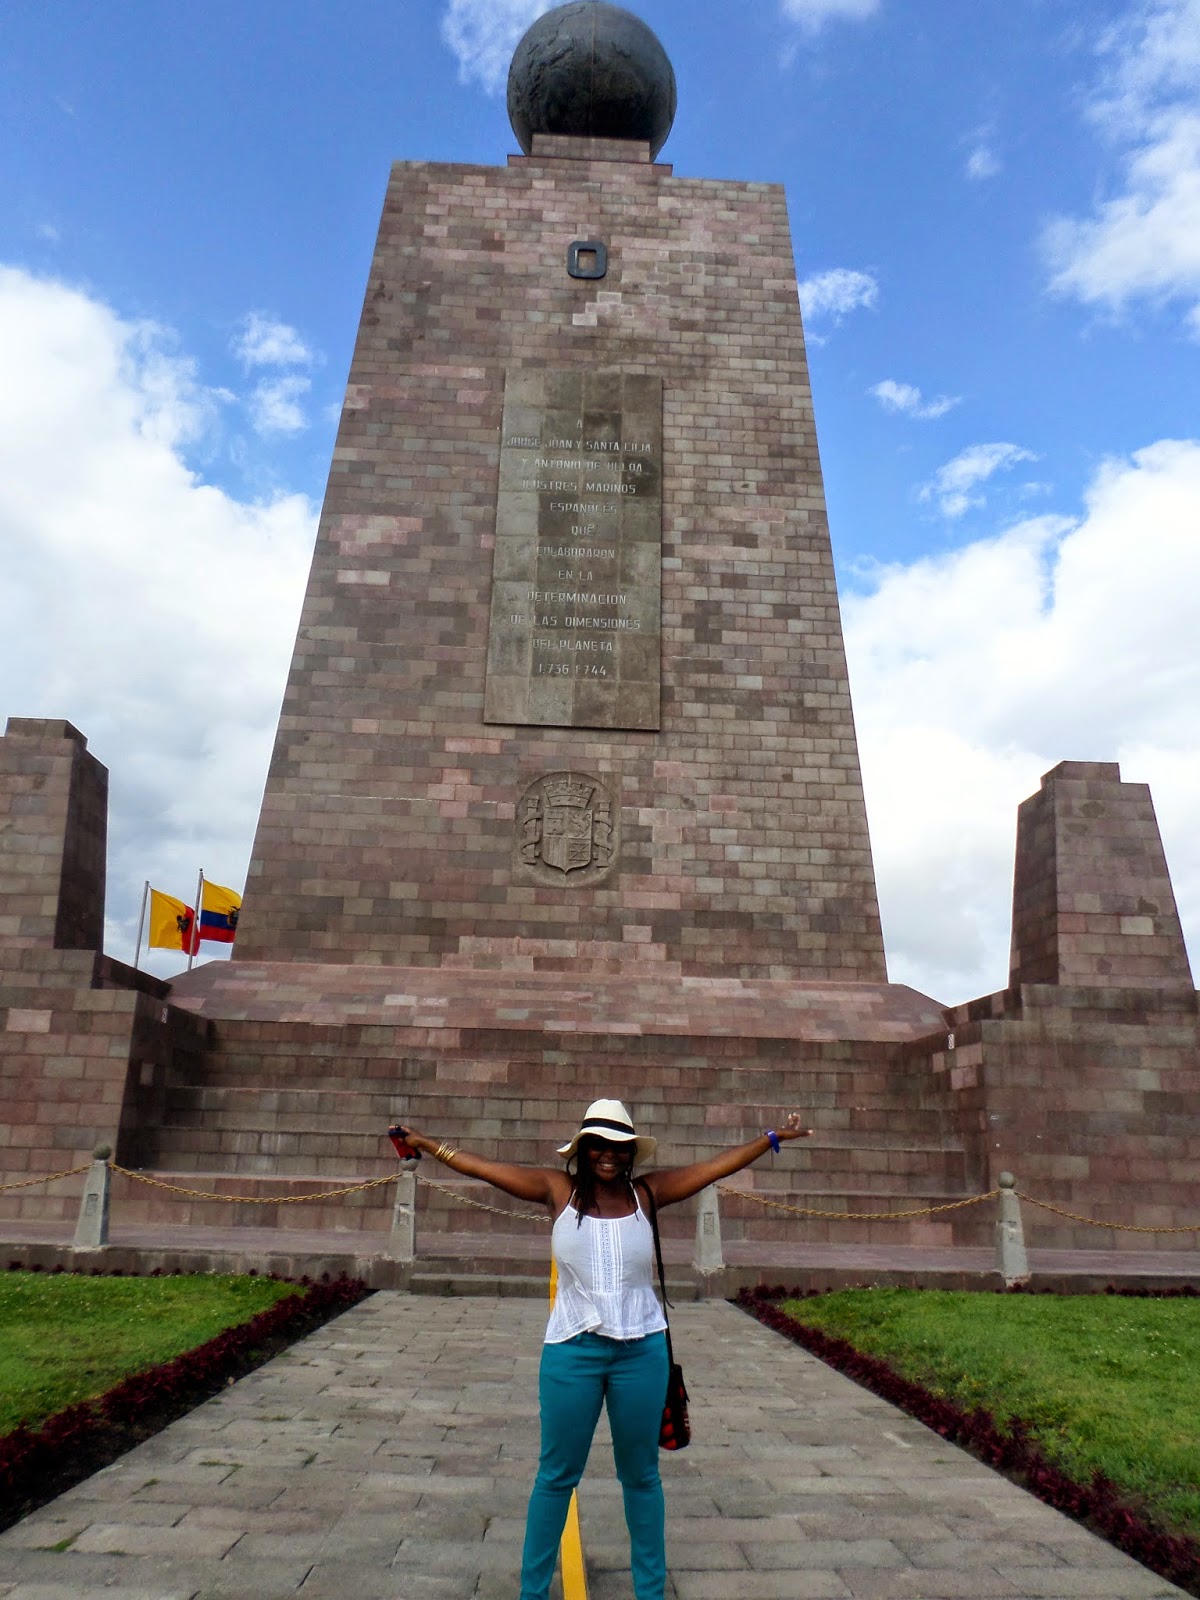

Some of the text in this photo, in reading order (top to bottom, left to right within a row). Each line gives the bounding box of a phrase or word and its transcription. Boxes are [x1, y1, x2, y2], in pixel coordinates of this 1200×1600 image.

[576, 419, 583, 428] A
[507, 436, 540, 447] JORGE
[545, 439, 573, 449] JUAN
[575, 440, 581, 449] Y
[586, 441, 620, 451] SANTA
[522, 458, 643, 473] Y ANTONIO DE ULLOA
[522, 480, 636, 494] ILUSTRES MARINOS
[571, 525, 594, 536] QUE
[536, 546, 615, 558] COLABORARON
[558, 570, 593, 581] EN LA
[527, 591, 626, 604] DETERMINACION
[510, 614, 640, 629] DE LAS DIMENSIONES
[532, 638, 612, 652] DEL PLANETA
